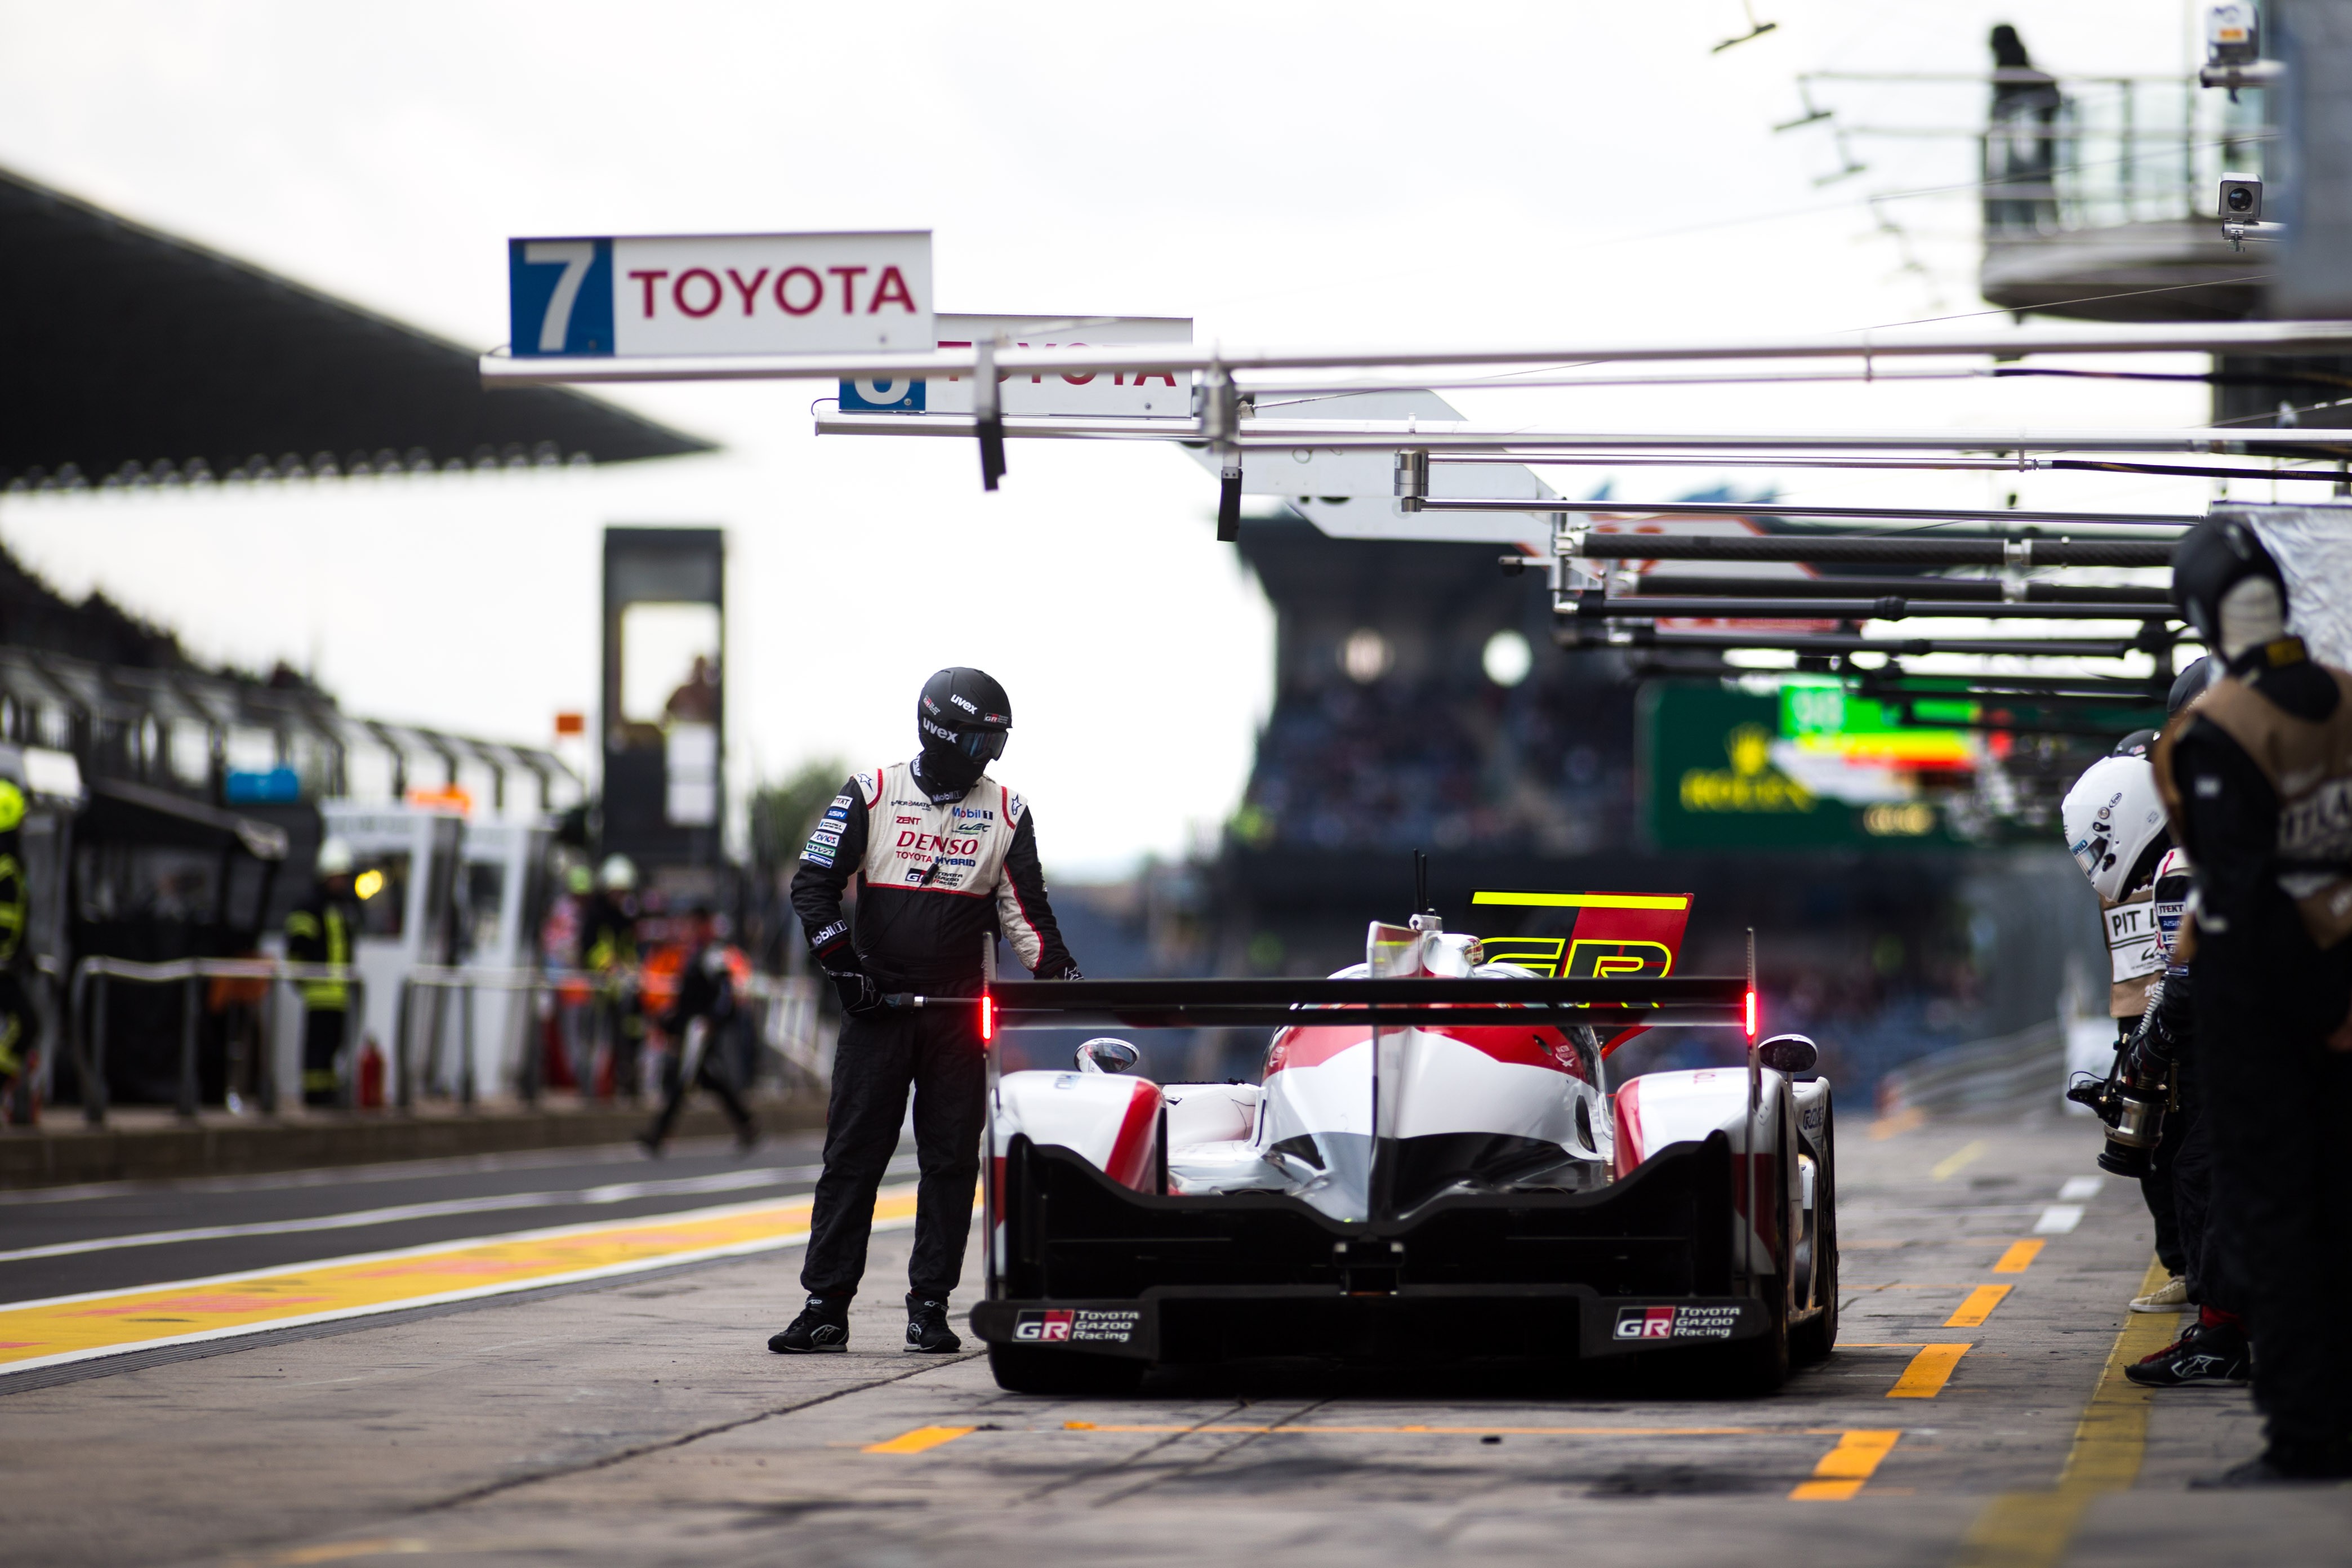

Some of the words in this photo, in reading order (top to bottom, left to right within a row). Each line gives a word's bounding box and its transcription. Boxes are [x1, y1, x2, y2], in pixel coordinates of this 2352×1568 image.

[524, 242, 595, 353] 7
[627, 265, 917, 319] TOYOTA
[950, 694, 978, 715] uvex
[923, 717, 959, 743] uvex
[932, 792, 954, 803] Mobil
[952, 805, 981, 818] Mobil
[896, 816, 921, 825] ZENT
[896, 831, 978, 855] DENSO
[896, 851, 932, 863] TOYOTA
[934, 856, 976, 867] HYBRID
[2159, 904, 2184, 914] JTEKT
[2112, 910, 2141, 936] PIT
[1077, 1310, 1141, 1320] TOYOTA
[1678, 1307, 1741, 1316] TOYOTA
[1074, 1321, 1134, 1330] GAZOO
[1676, 1317, 1734, 1326] GAZOO
[1015, 1322, 1069, 1339] GR
[1617, 1319, 1669, 1337] GR
[1673, 1327, 1731, 1338] Racing
[1072, 1331, 1130, 1343] Racing
